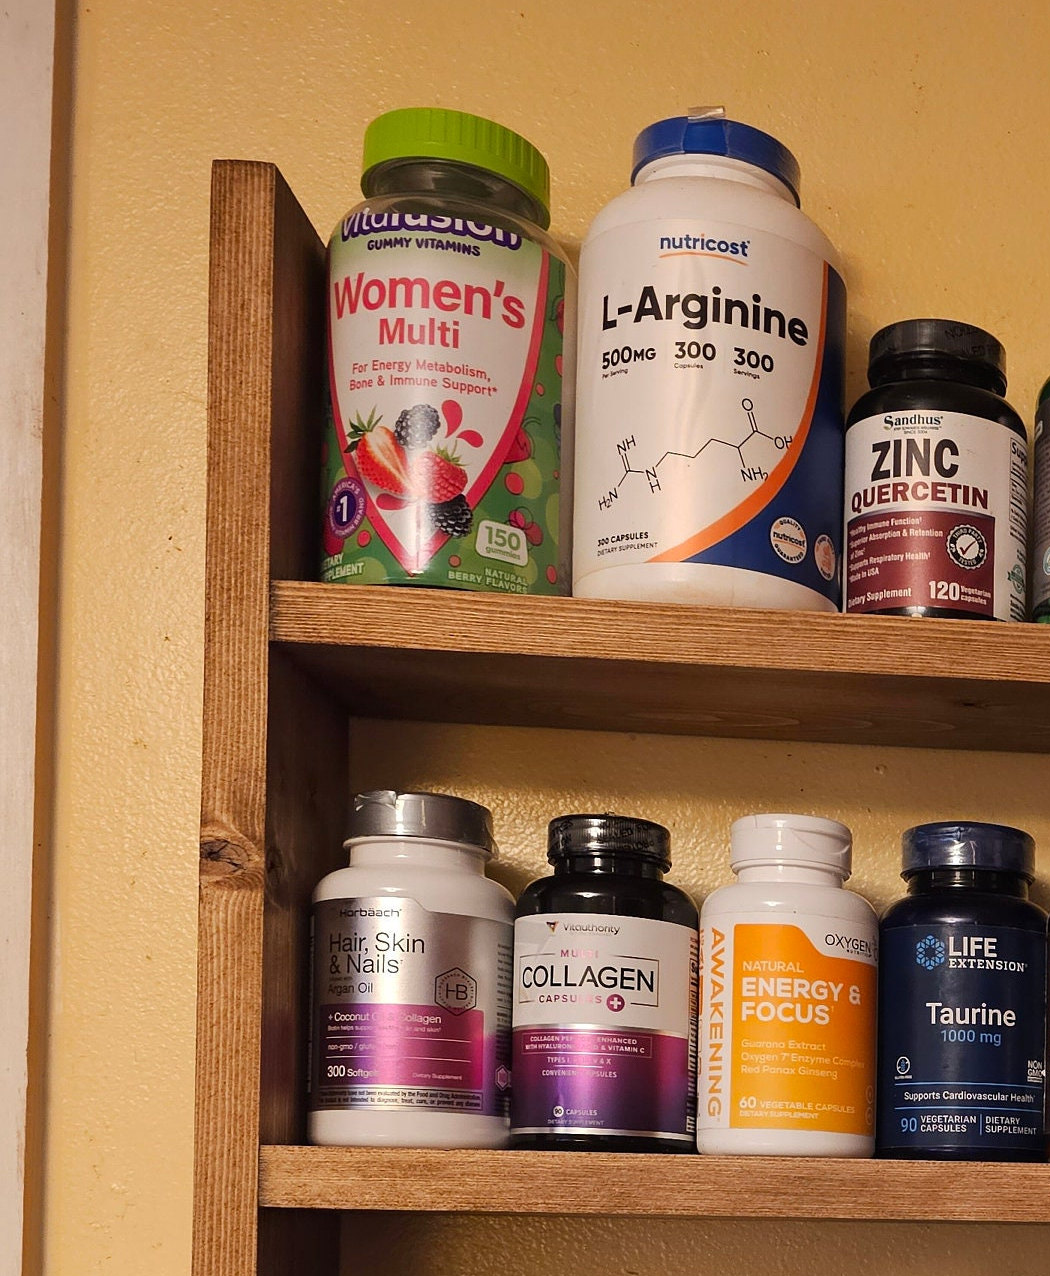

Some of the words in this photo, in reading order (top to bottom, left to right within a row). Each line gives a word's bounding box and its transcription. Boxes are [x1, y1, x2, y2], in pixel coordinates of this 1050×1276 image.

[367, 238, 412, 252] GUMMY
[416, 238, 480, 256] VITAMINS
[660, 233, 750, 257] nutricost
[334, 272, 526, 329] Women's
[602, 286, 808, 346] L-Arginine
[379, 318, 460, 348] Multi
[602, 345, 656, 369] 500MG
[674, 342, 716, 361] 300
[734, 348, 774, 373] 300
[352, 362, 369, 374] For
[372, 359, 412, 373] Energy
[416, 360, 491, 381] Metabolism,
[884, 415, 941, 428] Sandhus
[871, 439, 959, 482] ZINC
[851, 482, 988, 512] QUERCETIN
[484, 525, 521, 550] 150
[564, 924, 620, 935] Vitauthority
[330, 934, 368, 954] Hair,
[376, 932, 424, 953] Skin
[949, 937, 997, 957] LIFE
[330, 955, 339, 974] &
[347, 955, 399, 974] Nails
[743, 961, 804, 973] NATURAL
[949, 958, 1024, 972] EXTENSION
[522, 965, 654, 992] COLLAGEN
[742, 977, 843, 1001] ENERGY
[849, 985, 861, 1005] &
[708, 928, 725, 1117] AWAKENING
[742, 1002, 830, 1025] FOCUS
[926, 1003, 1016, 1027] Taurine
[941, 1030, 975, 1042] 1000
[980, 1031, 1001, 1046] mg
[904, 1092, 940, 1101] Supports
[943, 1091, 1008, 1101] Cardiovascular
[1011, 1094, 1034, 1102] Health
